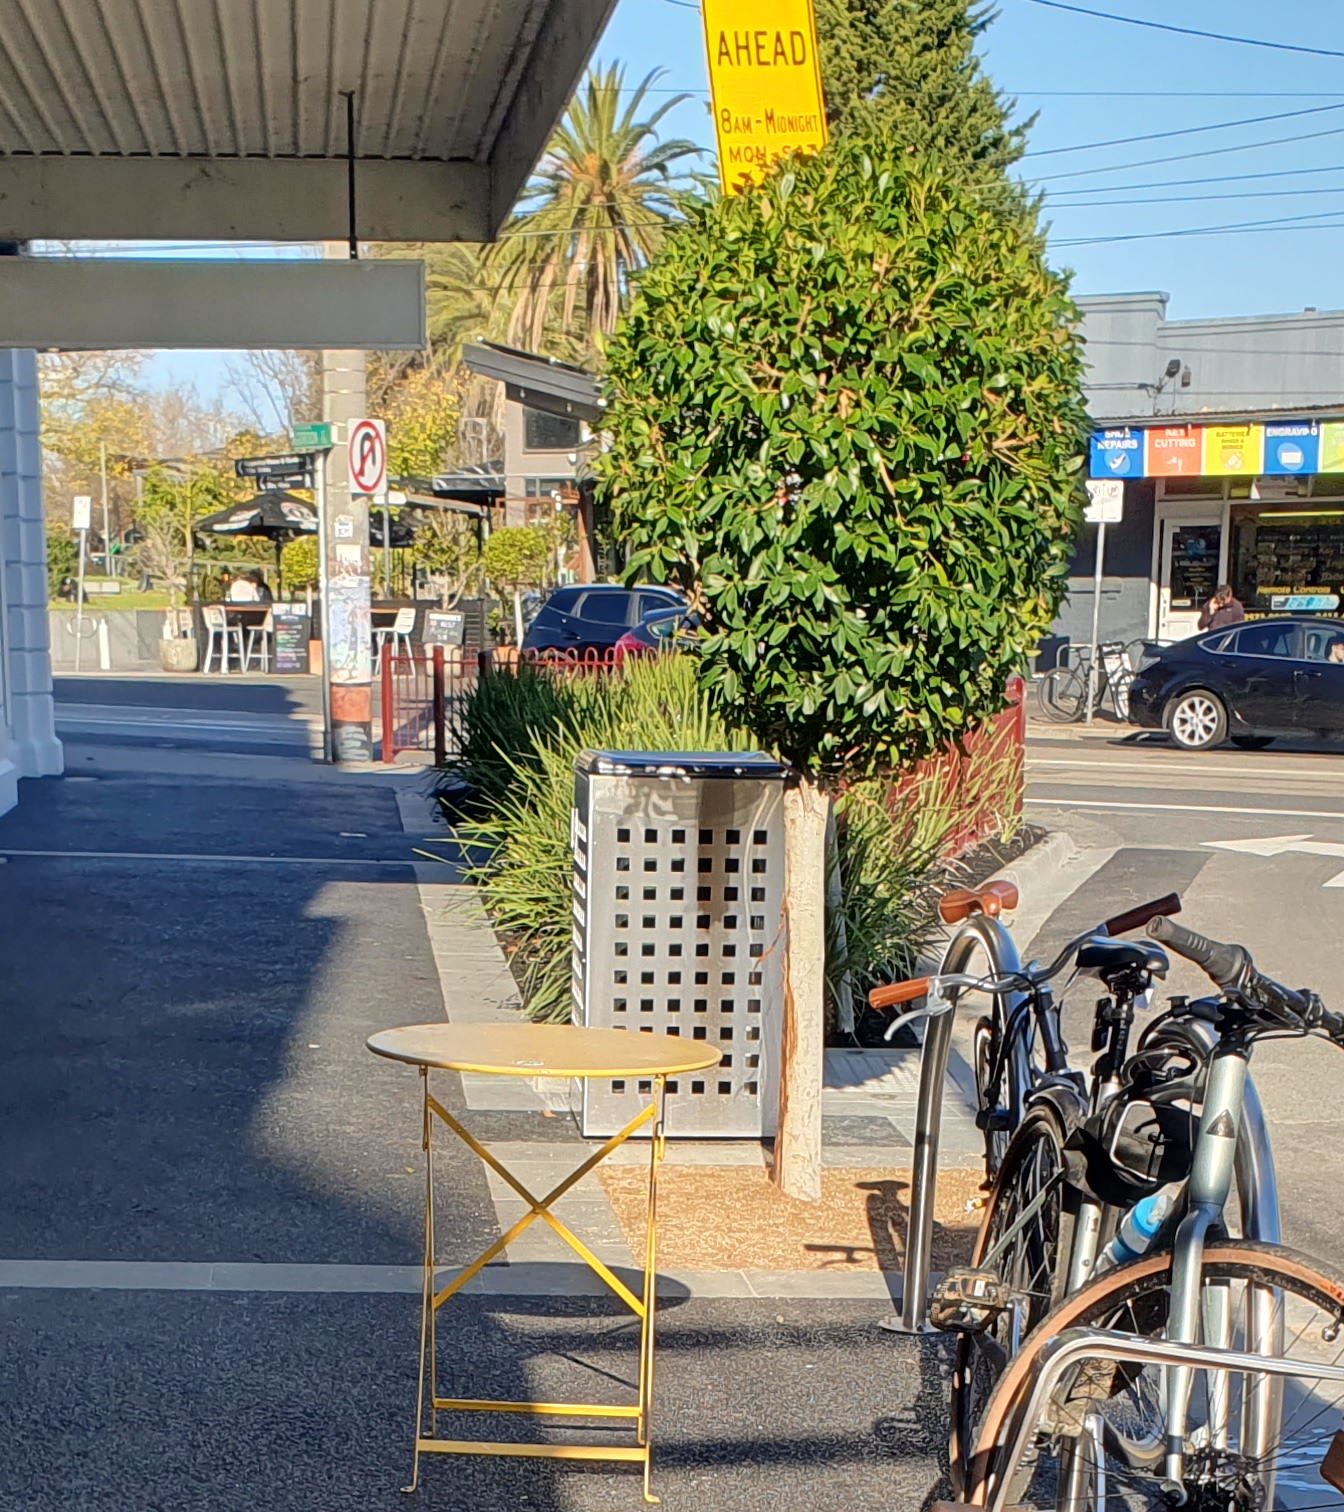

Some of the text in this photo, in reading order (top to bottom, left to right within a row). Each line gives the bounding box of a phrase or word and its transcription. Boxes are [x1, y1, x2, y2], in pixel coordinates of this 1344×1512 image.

[717, 30, 807, 67] AHEAD
[1097, 439, 1138, 450] REPAIRS
[1154, 438, 1197, 448] CUTTING
[1257, 585, 1332, 595] Remote Controls
